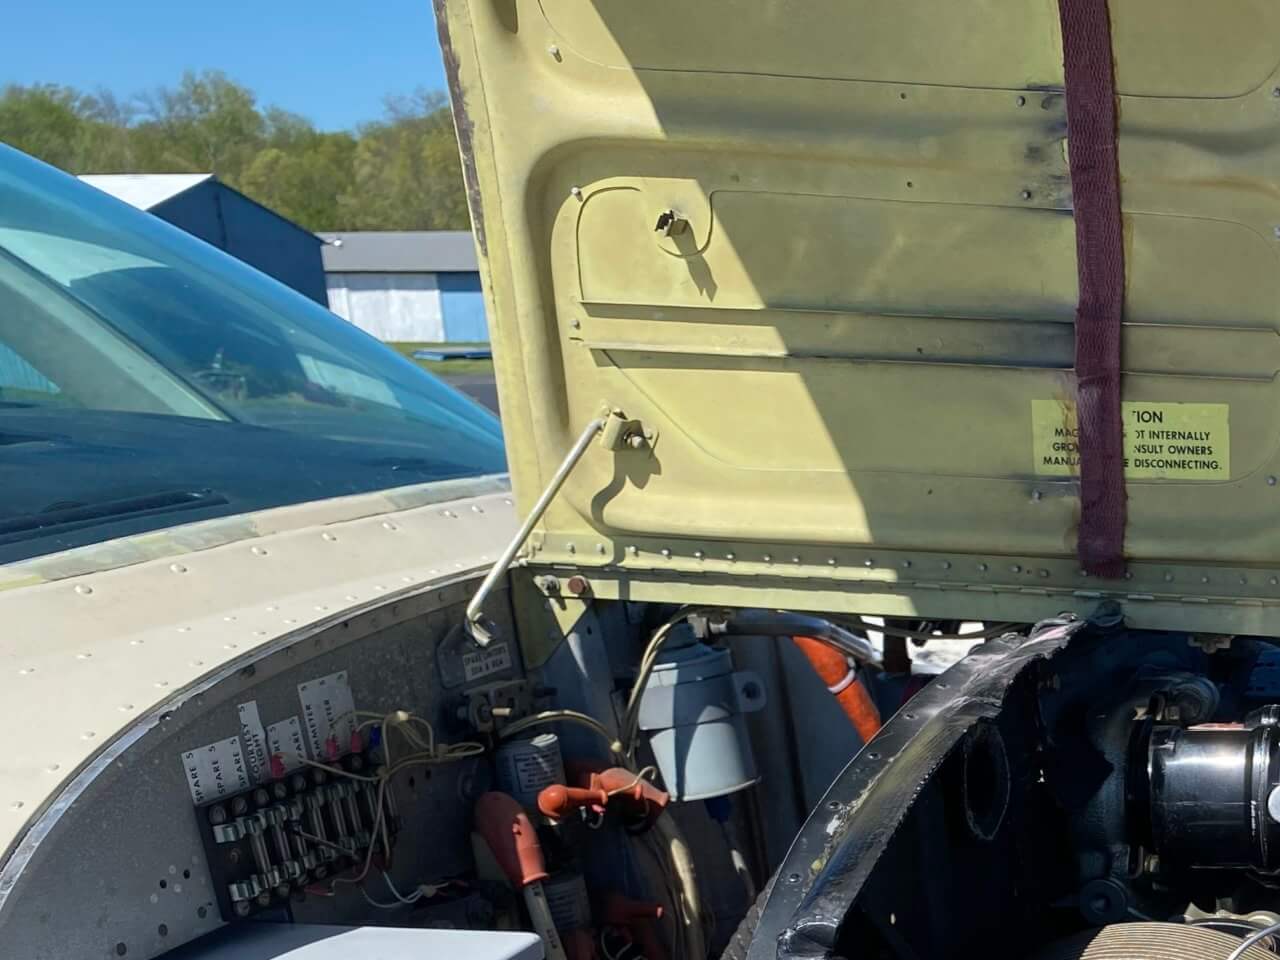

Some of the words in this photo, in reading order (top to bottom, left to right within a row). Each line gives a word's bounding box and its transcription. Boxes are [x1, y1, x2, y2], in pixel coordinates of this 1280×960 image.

[1149, 430, 1210, 441] INTERNALLY
[1168, 444, 1213, 455] OWNERS
[1134, 459, 1223, 470] DISCONNECTING.
[211, 760, 226, 794] SPARE
[189, 766, 204, 802] SPARE
